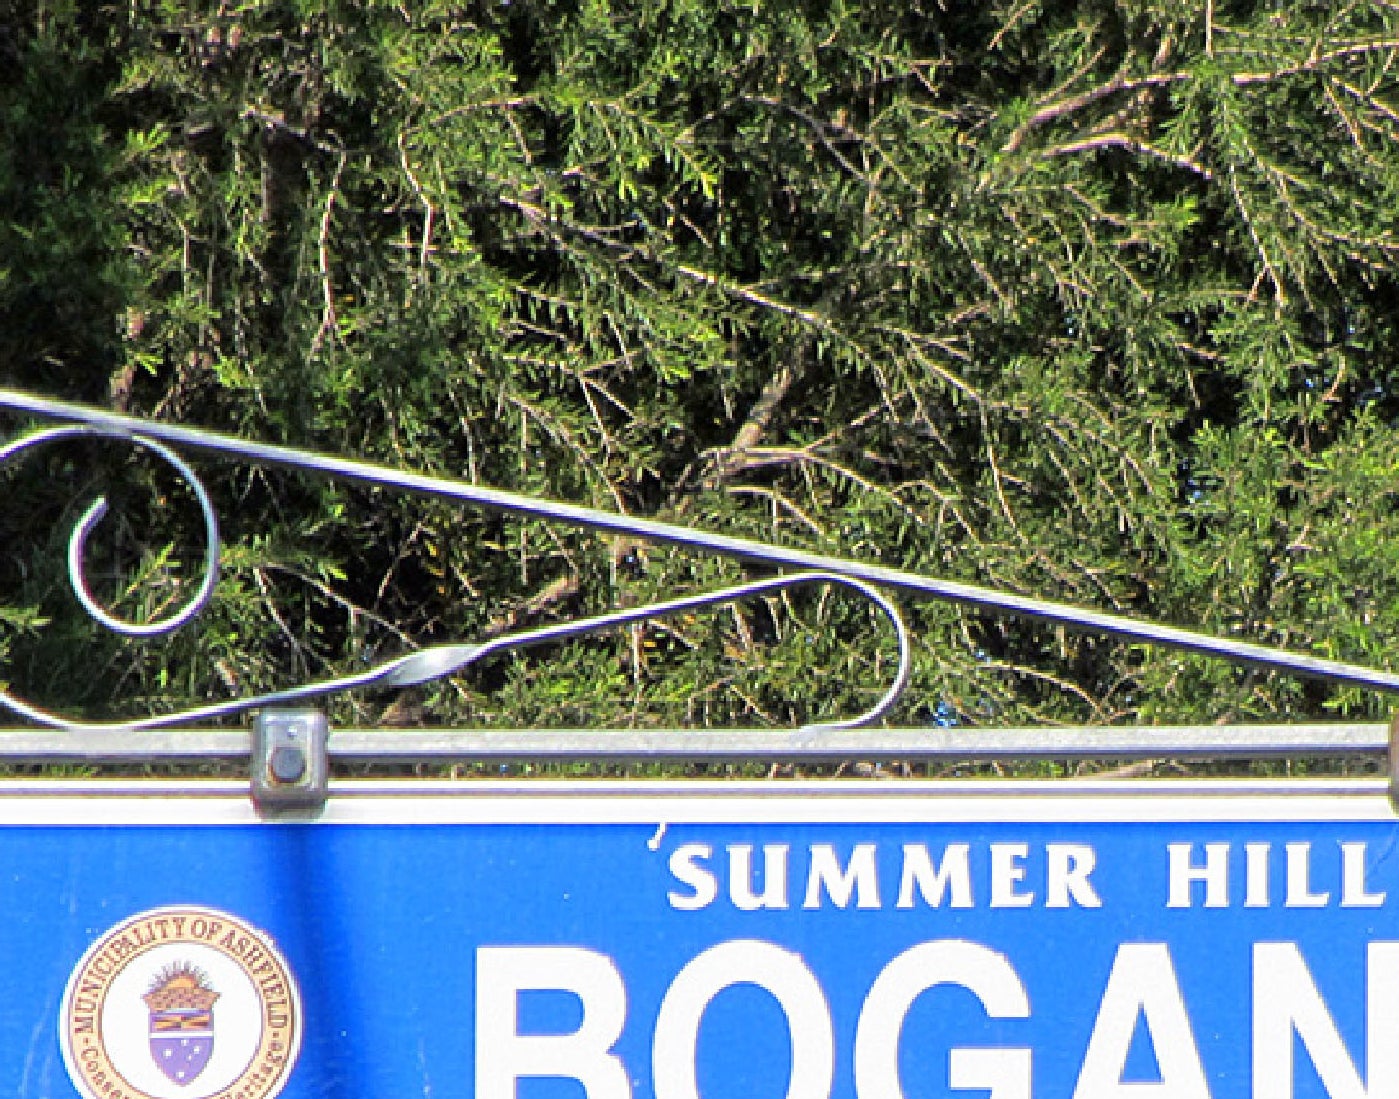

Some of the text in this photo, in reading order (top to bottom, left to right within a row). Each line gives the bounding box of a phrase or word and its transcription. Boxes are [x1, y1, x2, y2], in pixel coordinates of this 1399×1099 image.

[667, 840, 1388, 911] SUMMER HILL
[74, 916, 289, 1034] MUNICIPALITY OF ASHFIELD
